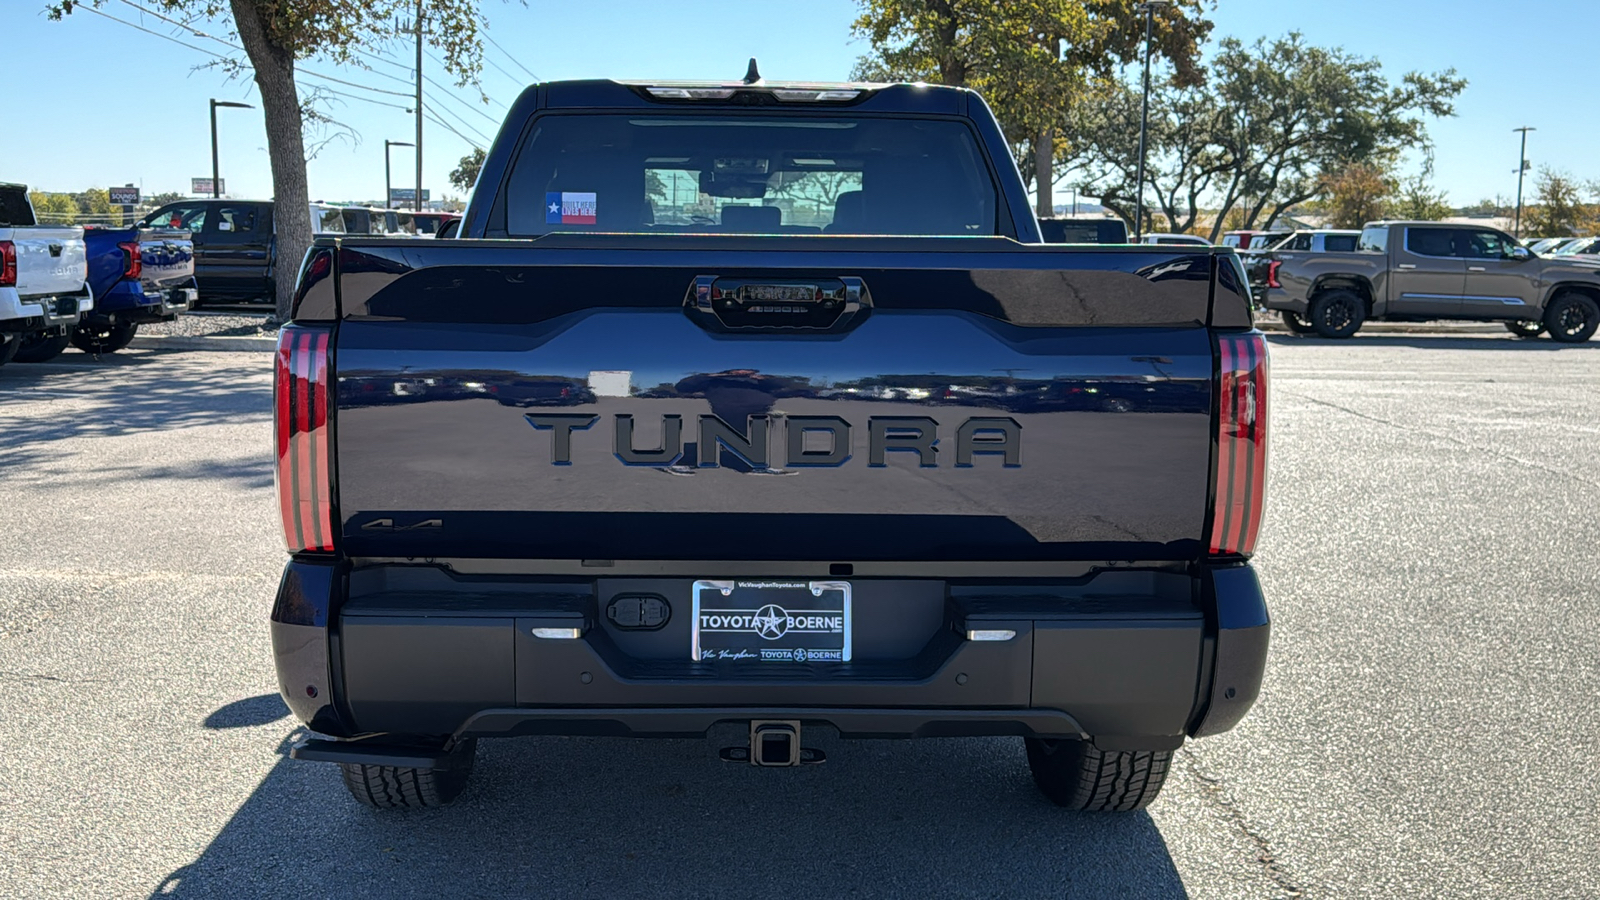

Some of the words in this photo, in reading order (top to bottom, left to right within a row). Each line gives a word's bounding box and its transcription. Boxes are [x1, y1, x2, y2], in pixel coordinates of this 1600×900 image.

[562, 208, 579, 216] LIVES
[580, 208, 596, 216] HERE
[523, 413, 1024, 468] TUNDRA
[700, 615, 762, 628] TOYOTA
[787, 616, 843, 629] BOERNE
[702, 649, 717, 660] Vic
[718, 649, 758, 661] Vaughan
[760, 651, 793, 659] TOYOTA
[807, 652, 842, 660] BOERNE
